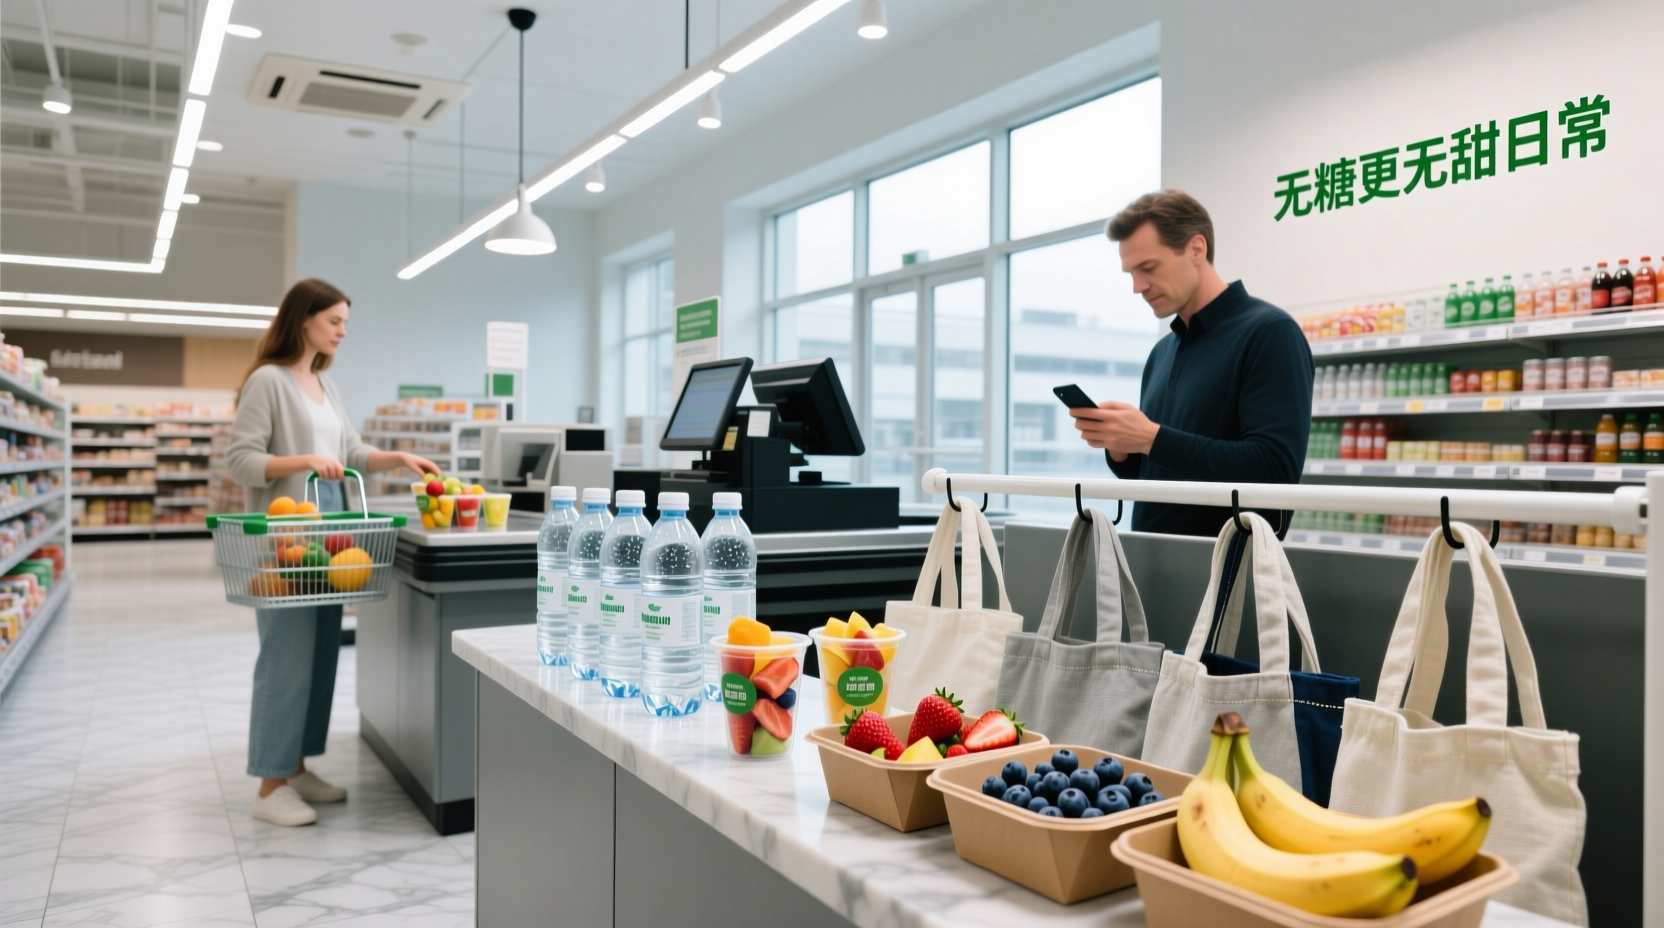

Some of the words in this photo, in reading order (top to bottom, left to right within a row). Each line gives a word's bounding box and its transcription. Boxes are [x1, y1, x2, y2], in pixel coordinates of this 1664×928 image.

[1274, 94, 1611, 222] 无糖更无甜日常
